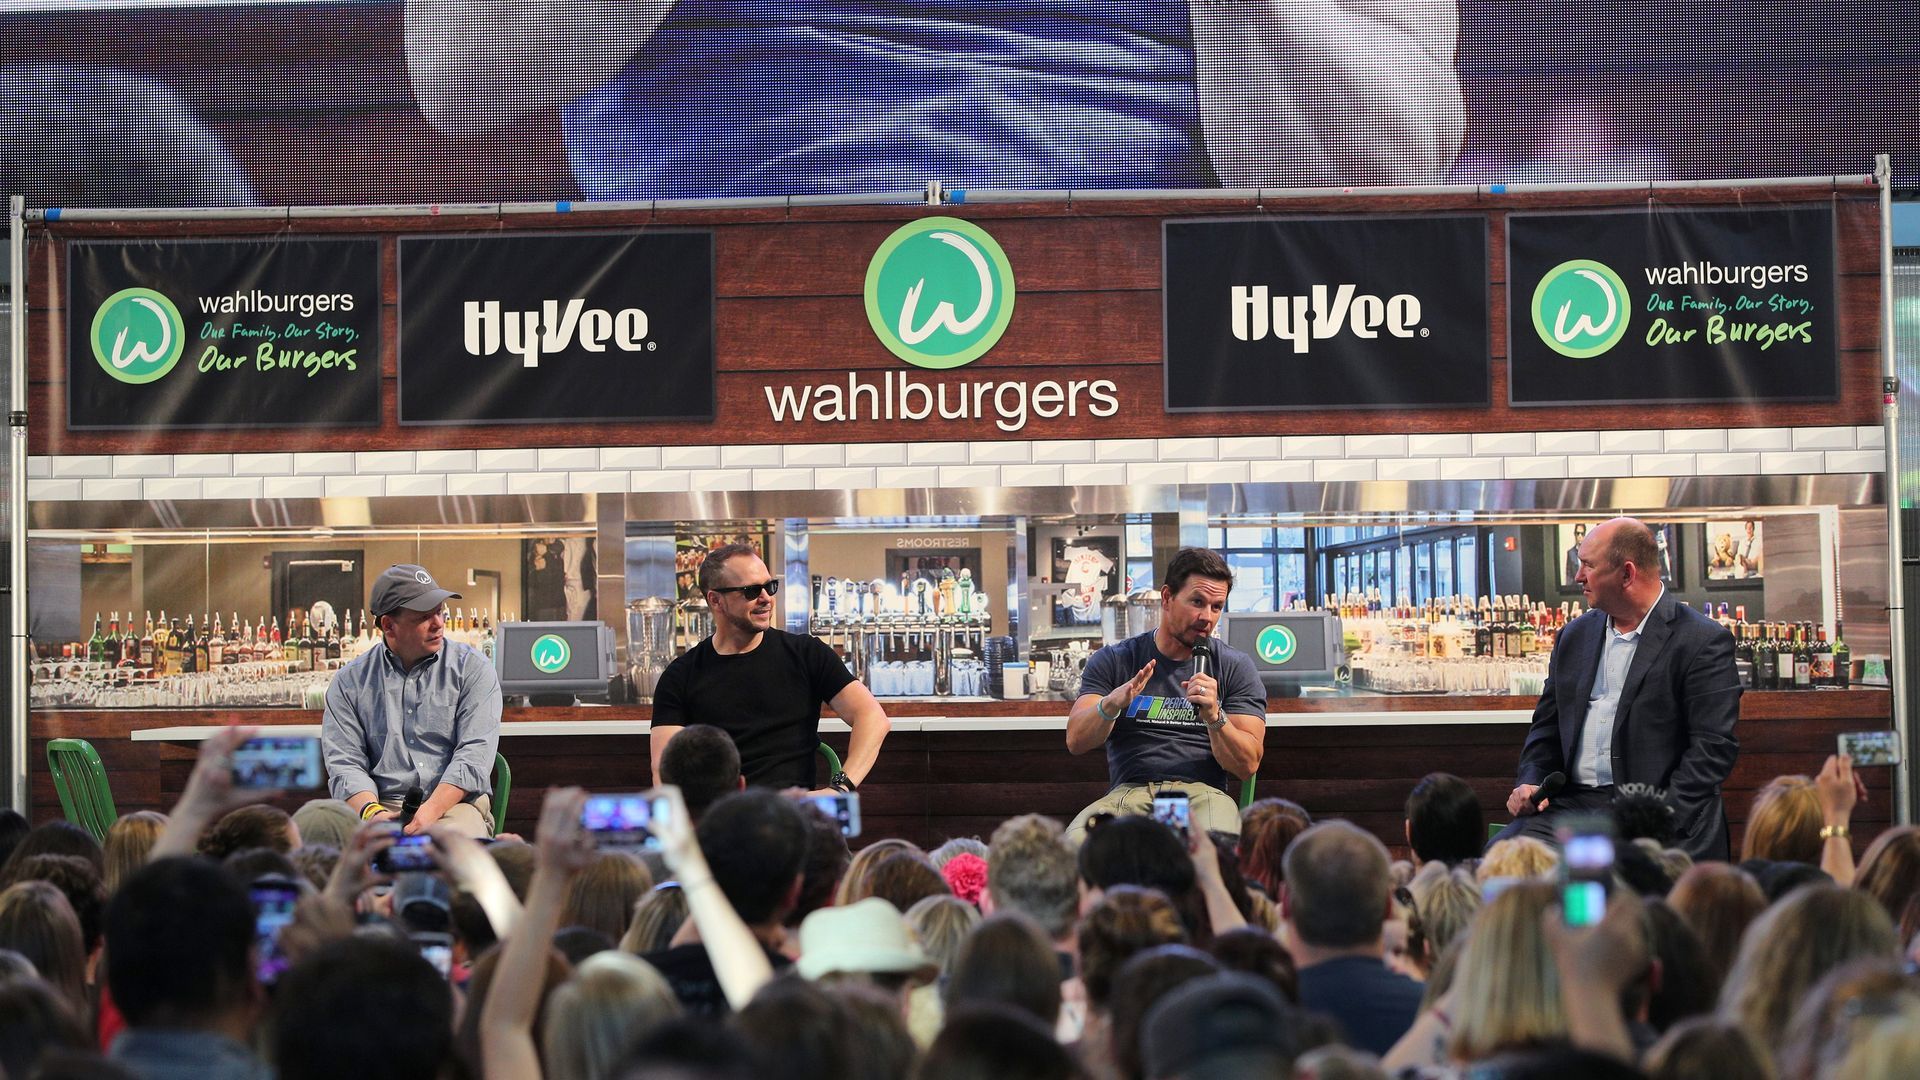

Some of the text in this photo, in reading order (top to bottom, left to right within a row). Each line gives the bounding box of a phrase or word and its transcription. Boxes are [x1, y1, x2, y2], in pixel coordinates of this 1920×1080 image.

[1645, 261, 1809, 290] wahlburgers
[198, 290, 354, 318] wahlburgers
[1681, 295, 1732, 315] Family,
[1768, 293, 1815, 315] Story,
[232, 323, 281, 342] Family,
[315, 322, 360, 343] Story,
[1645, 315, 1812, 351] Our Burgers
[198, 342, 357, 378] Our Burgers
[764, 371, 1119, 432] wahlburgers
